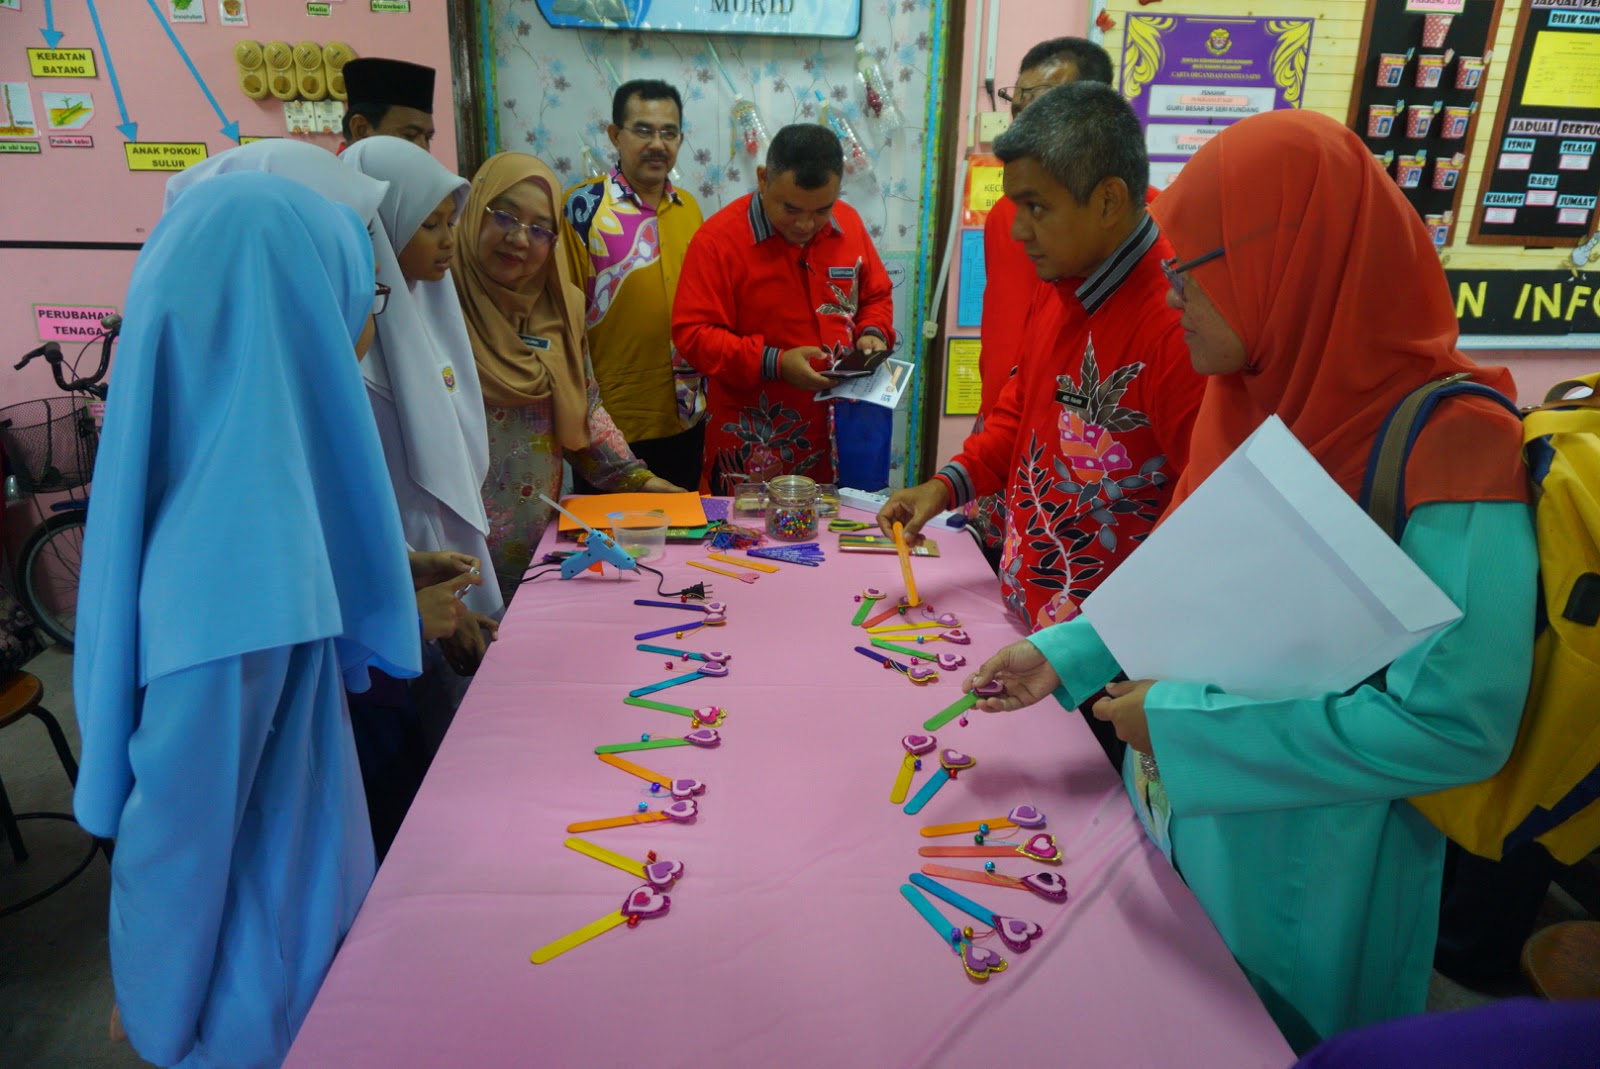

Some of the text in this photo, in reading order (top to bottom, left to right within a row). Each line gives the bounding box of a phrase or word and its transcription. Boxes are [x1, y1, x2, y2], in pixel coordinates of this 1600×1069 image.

[1551, 13, 1578, 24] BILIK
[36, 52, 86, 61] KERATAN
[43, 66, 85, 74] BATANG
[1512, 121, 1554, 132] JADUAL
[1507, 140, 1534, 149] ISNIN
[1562, 142, 1593, 152] SELASA
[132, 147, 160, 155] ANAK
[152, 160, 186, 168] SULUR
[1531, 176, 1556, 186] RABU
[1486, 194, 1524, 204] KHAMIS
[1560, 196, 1596, 206] JUMAAT
[53, 326, 104, 336] TENAGA
